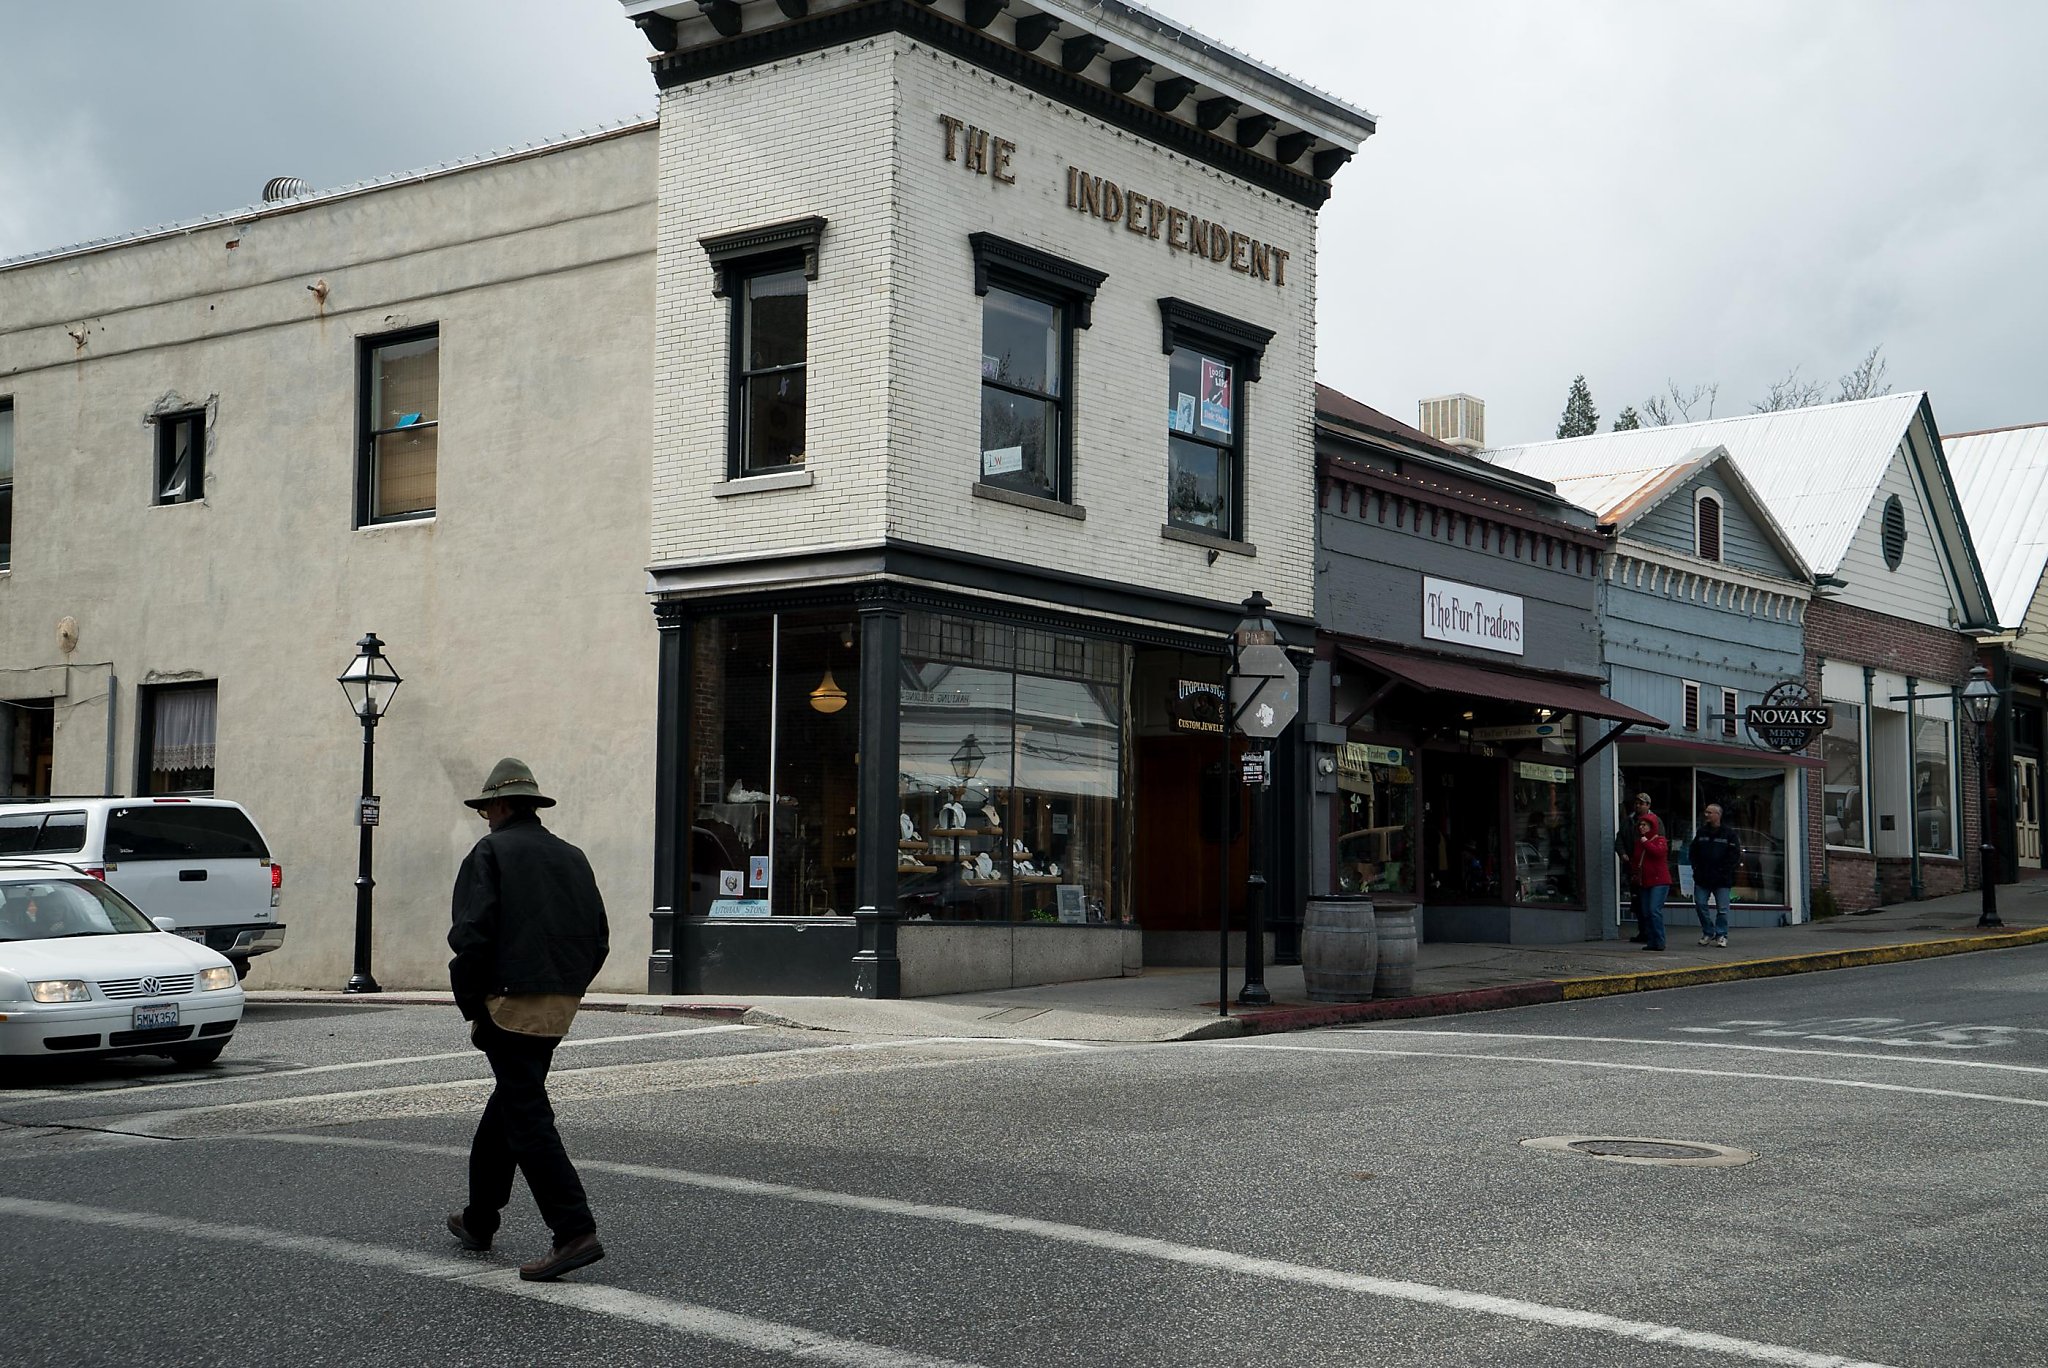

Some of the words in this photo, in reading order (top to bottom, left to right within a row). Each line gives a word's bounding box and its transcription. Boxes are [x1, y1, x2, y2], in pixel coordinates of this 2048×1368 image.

[940, 113, 1016, 185] THE
[1067, 165, 1290, 287] INDEPENDENT
[1428, 590, 1451, 637] The
[1452, 596, 1473, 633] Fur
[1473, 601, 1520, 642] Traders
[1179, 680, 1209, 699] UTOPIAN
[1209, 683, 1225, 700] STO
[1750, 709, 1827, 725] NOVAK'S
[1179, 719, 1200, 730] CUSTOM
[1200, 721, 1224, 733] JEWELE
[1769, 728, 1806, 738] MEN'S
[1769, 737, 1804, 746] WEAR
